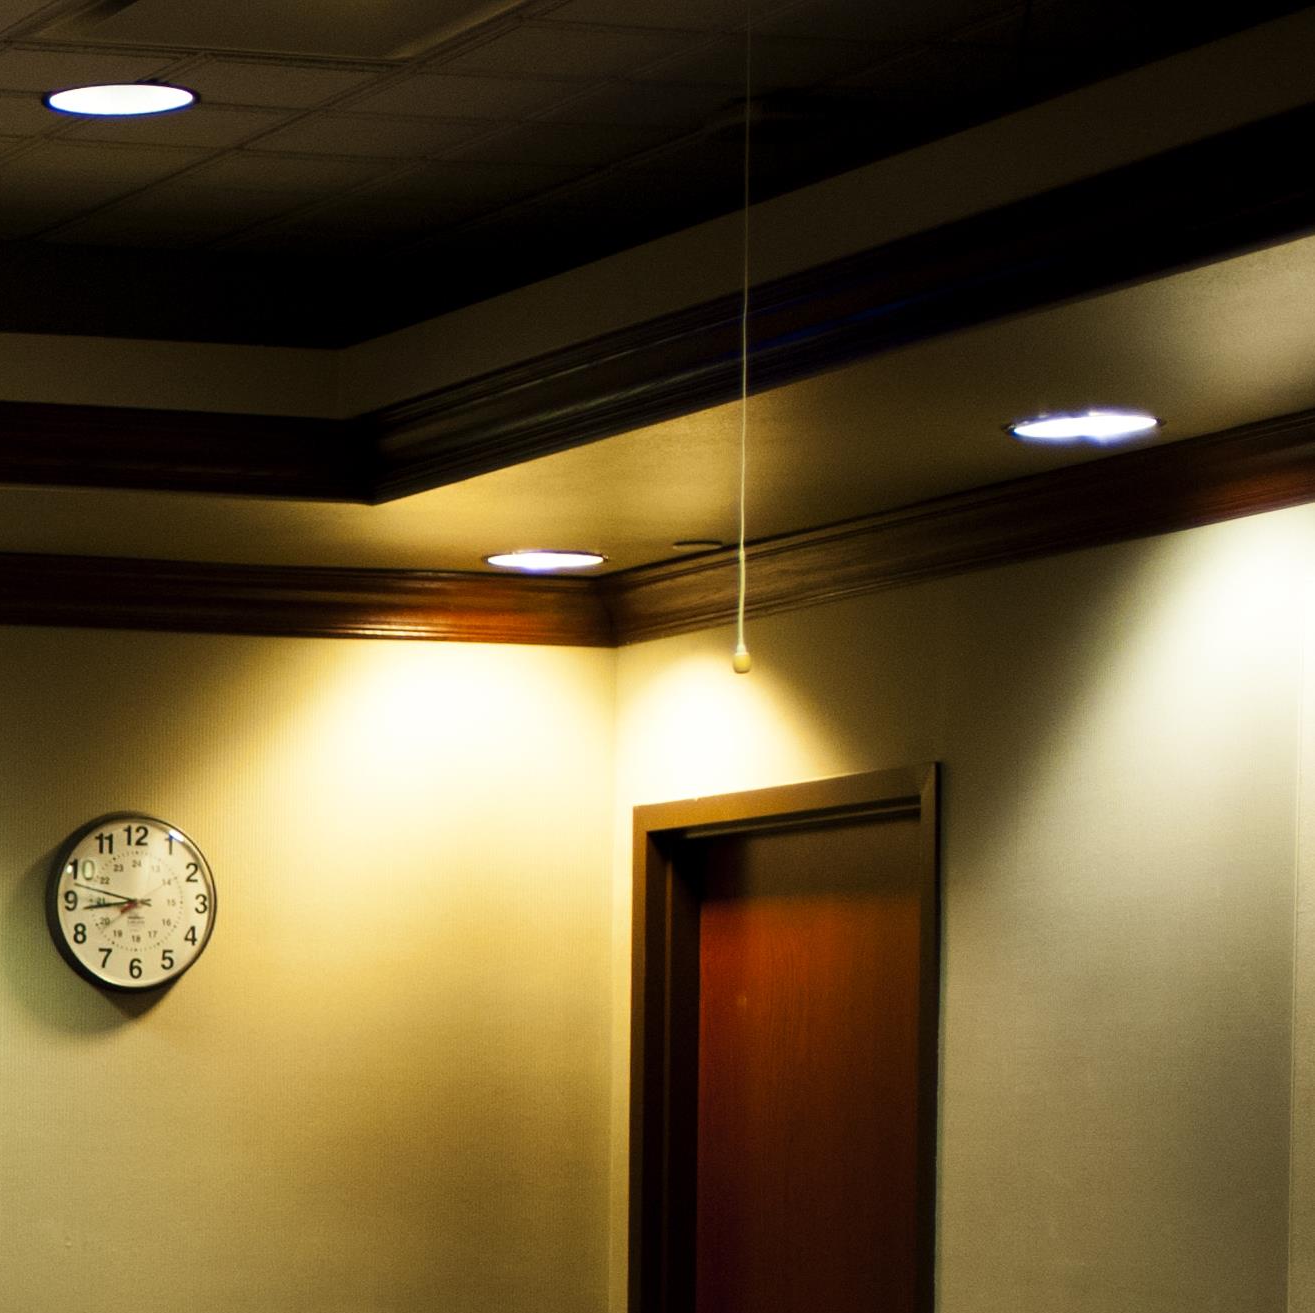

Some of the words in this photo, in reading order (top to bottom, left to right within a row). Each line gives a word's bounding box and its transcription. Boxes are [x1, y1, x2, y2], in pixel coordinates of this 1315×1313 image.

[95, 833, 114, 854] 11
[123, 825, 149, 847] 12
[165, 834, 173, 855] 1
[69, 859, 95, 881] 10
[185, 862, 199, 883] 2
[64, 890, 78, 911] 9
[194, 893, 208, 914] 3
[73, 923, 87, 944] 8
[184, 926, 198, 946] 4
[98, 948, 113, 968] 7
[129, 958, 143, 979] 6
[160, 950, 174, 970] 5
